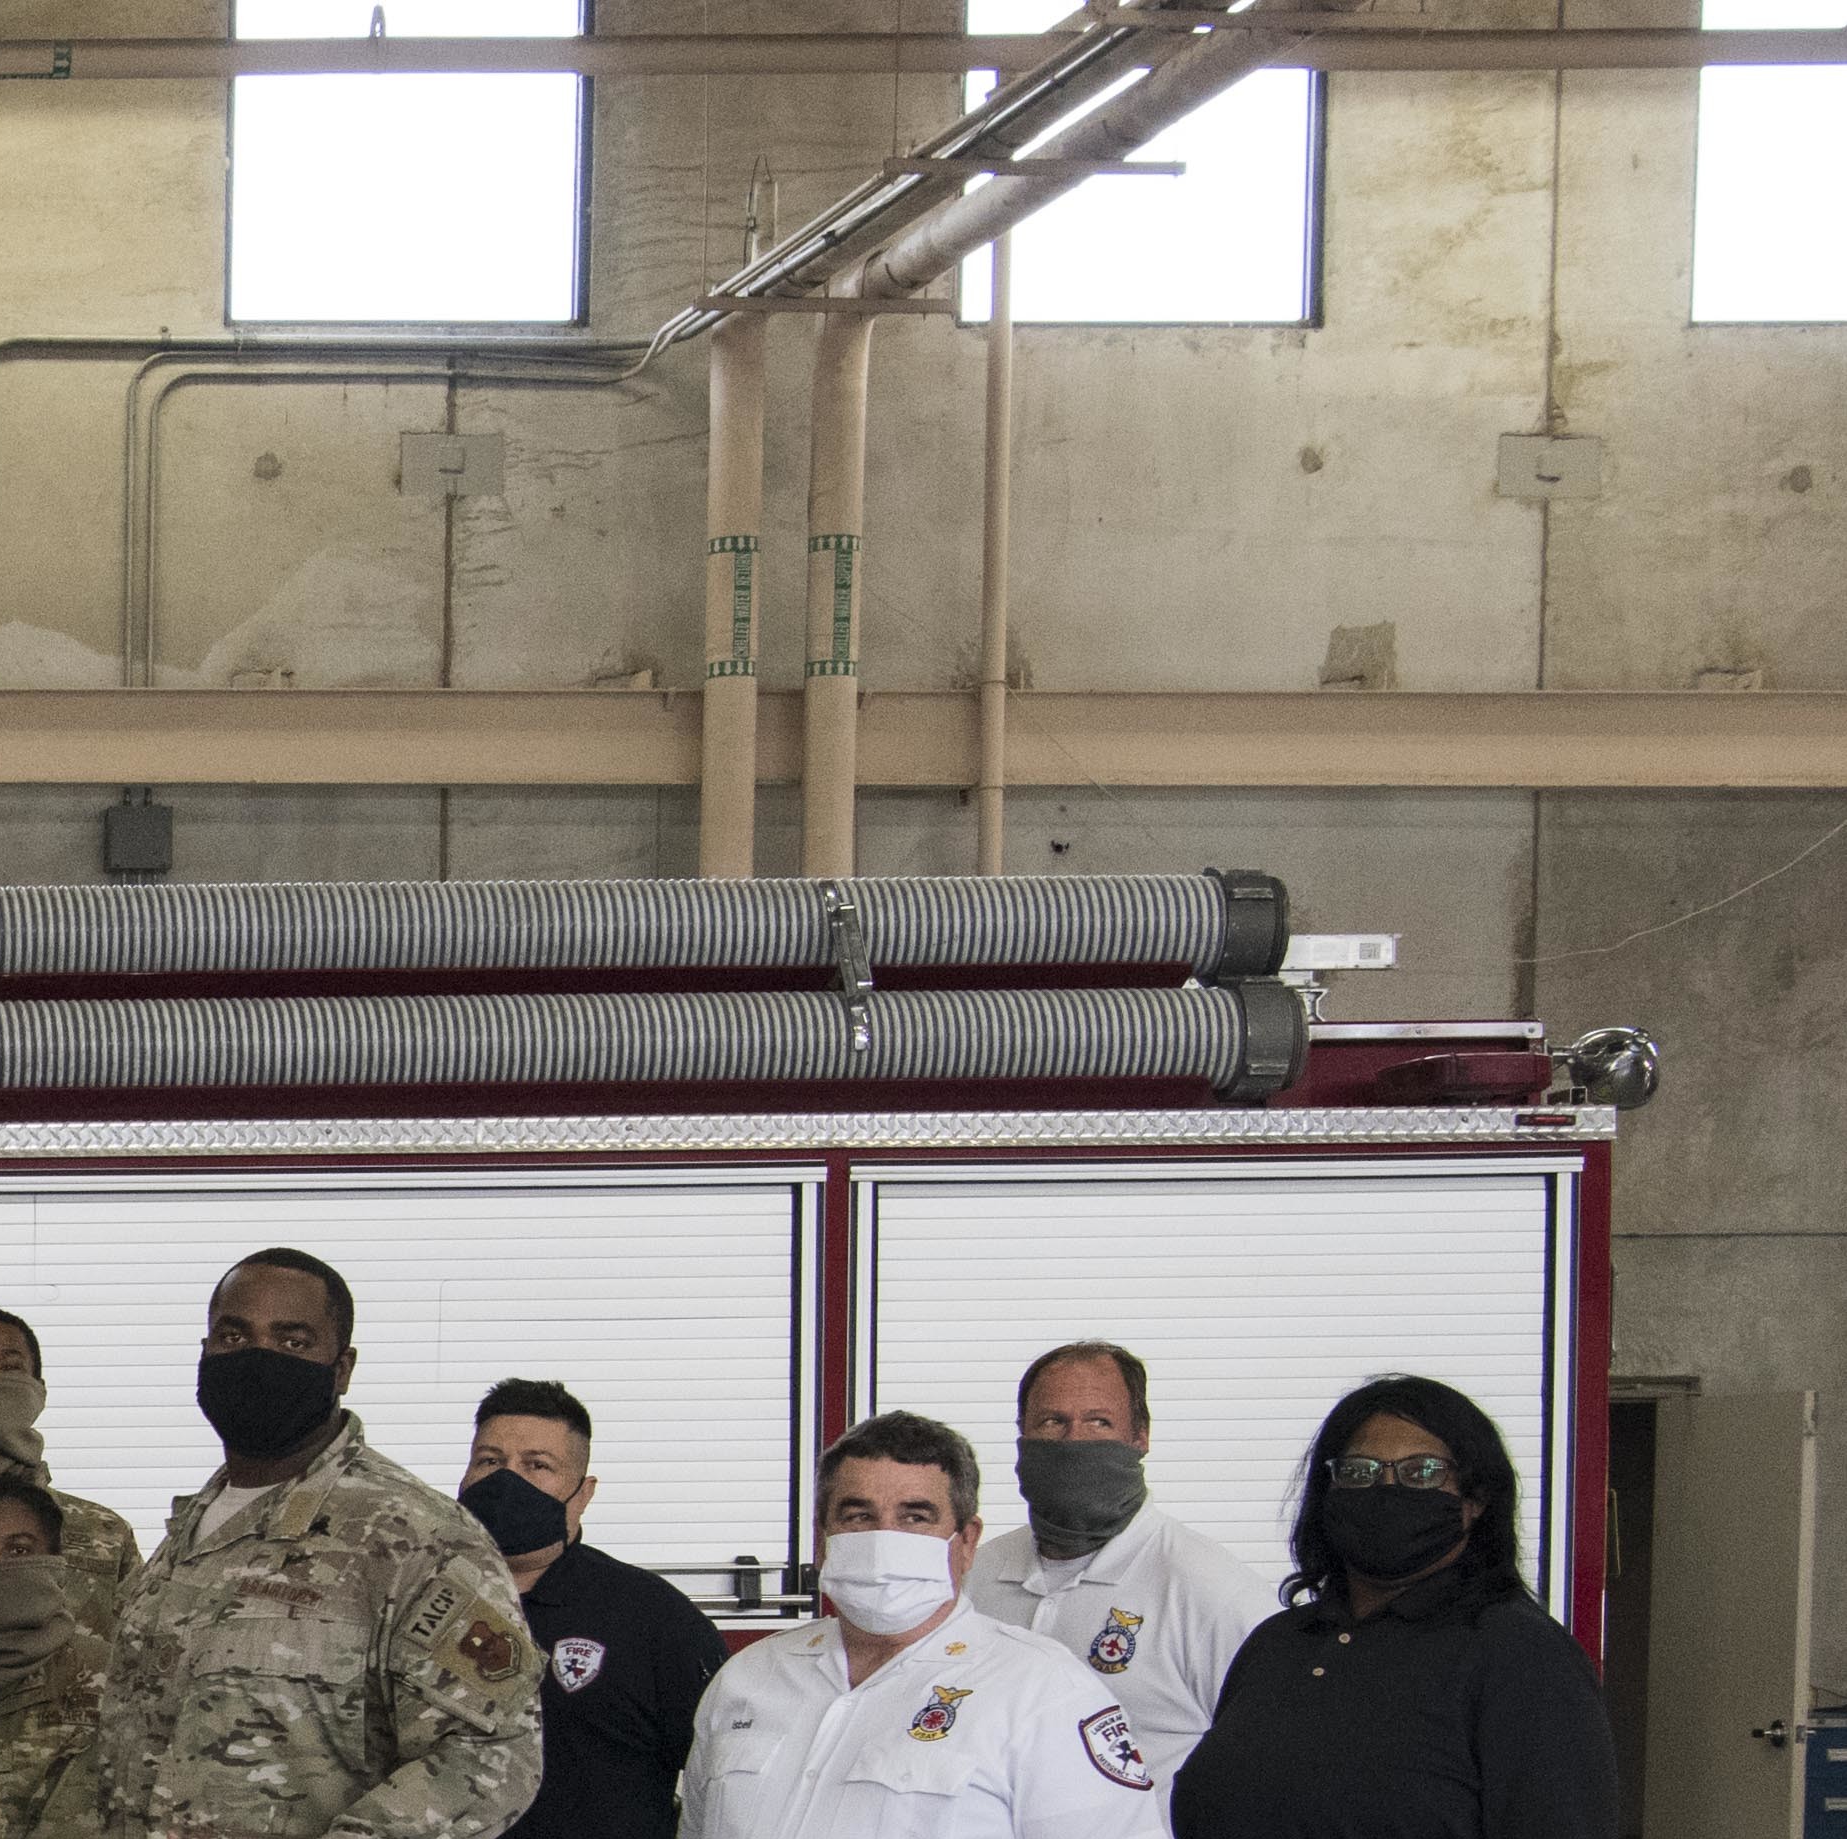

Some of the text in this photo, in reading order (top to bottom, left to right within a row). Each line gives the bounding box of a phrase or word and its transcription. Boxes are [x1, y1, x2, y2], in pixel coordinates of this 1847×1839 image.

[734, 589, 750, 618] WATER
[835, 587, 851, 618] WATER
[566, 1647, 593, 1659] FIRE
[1101, 1721, 1129, 1742] FIR
